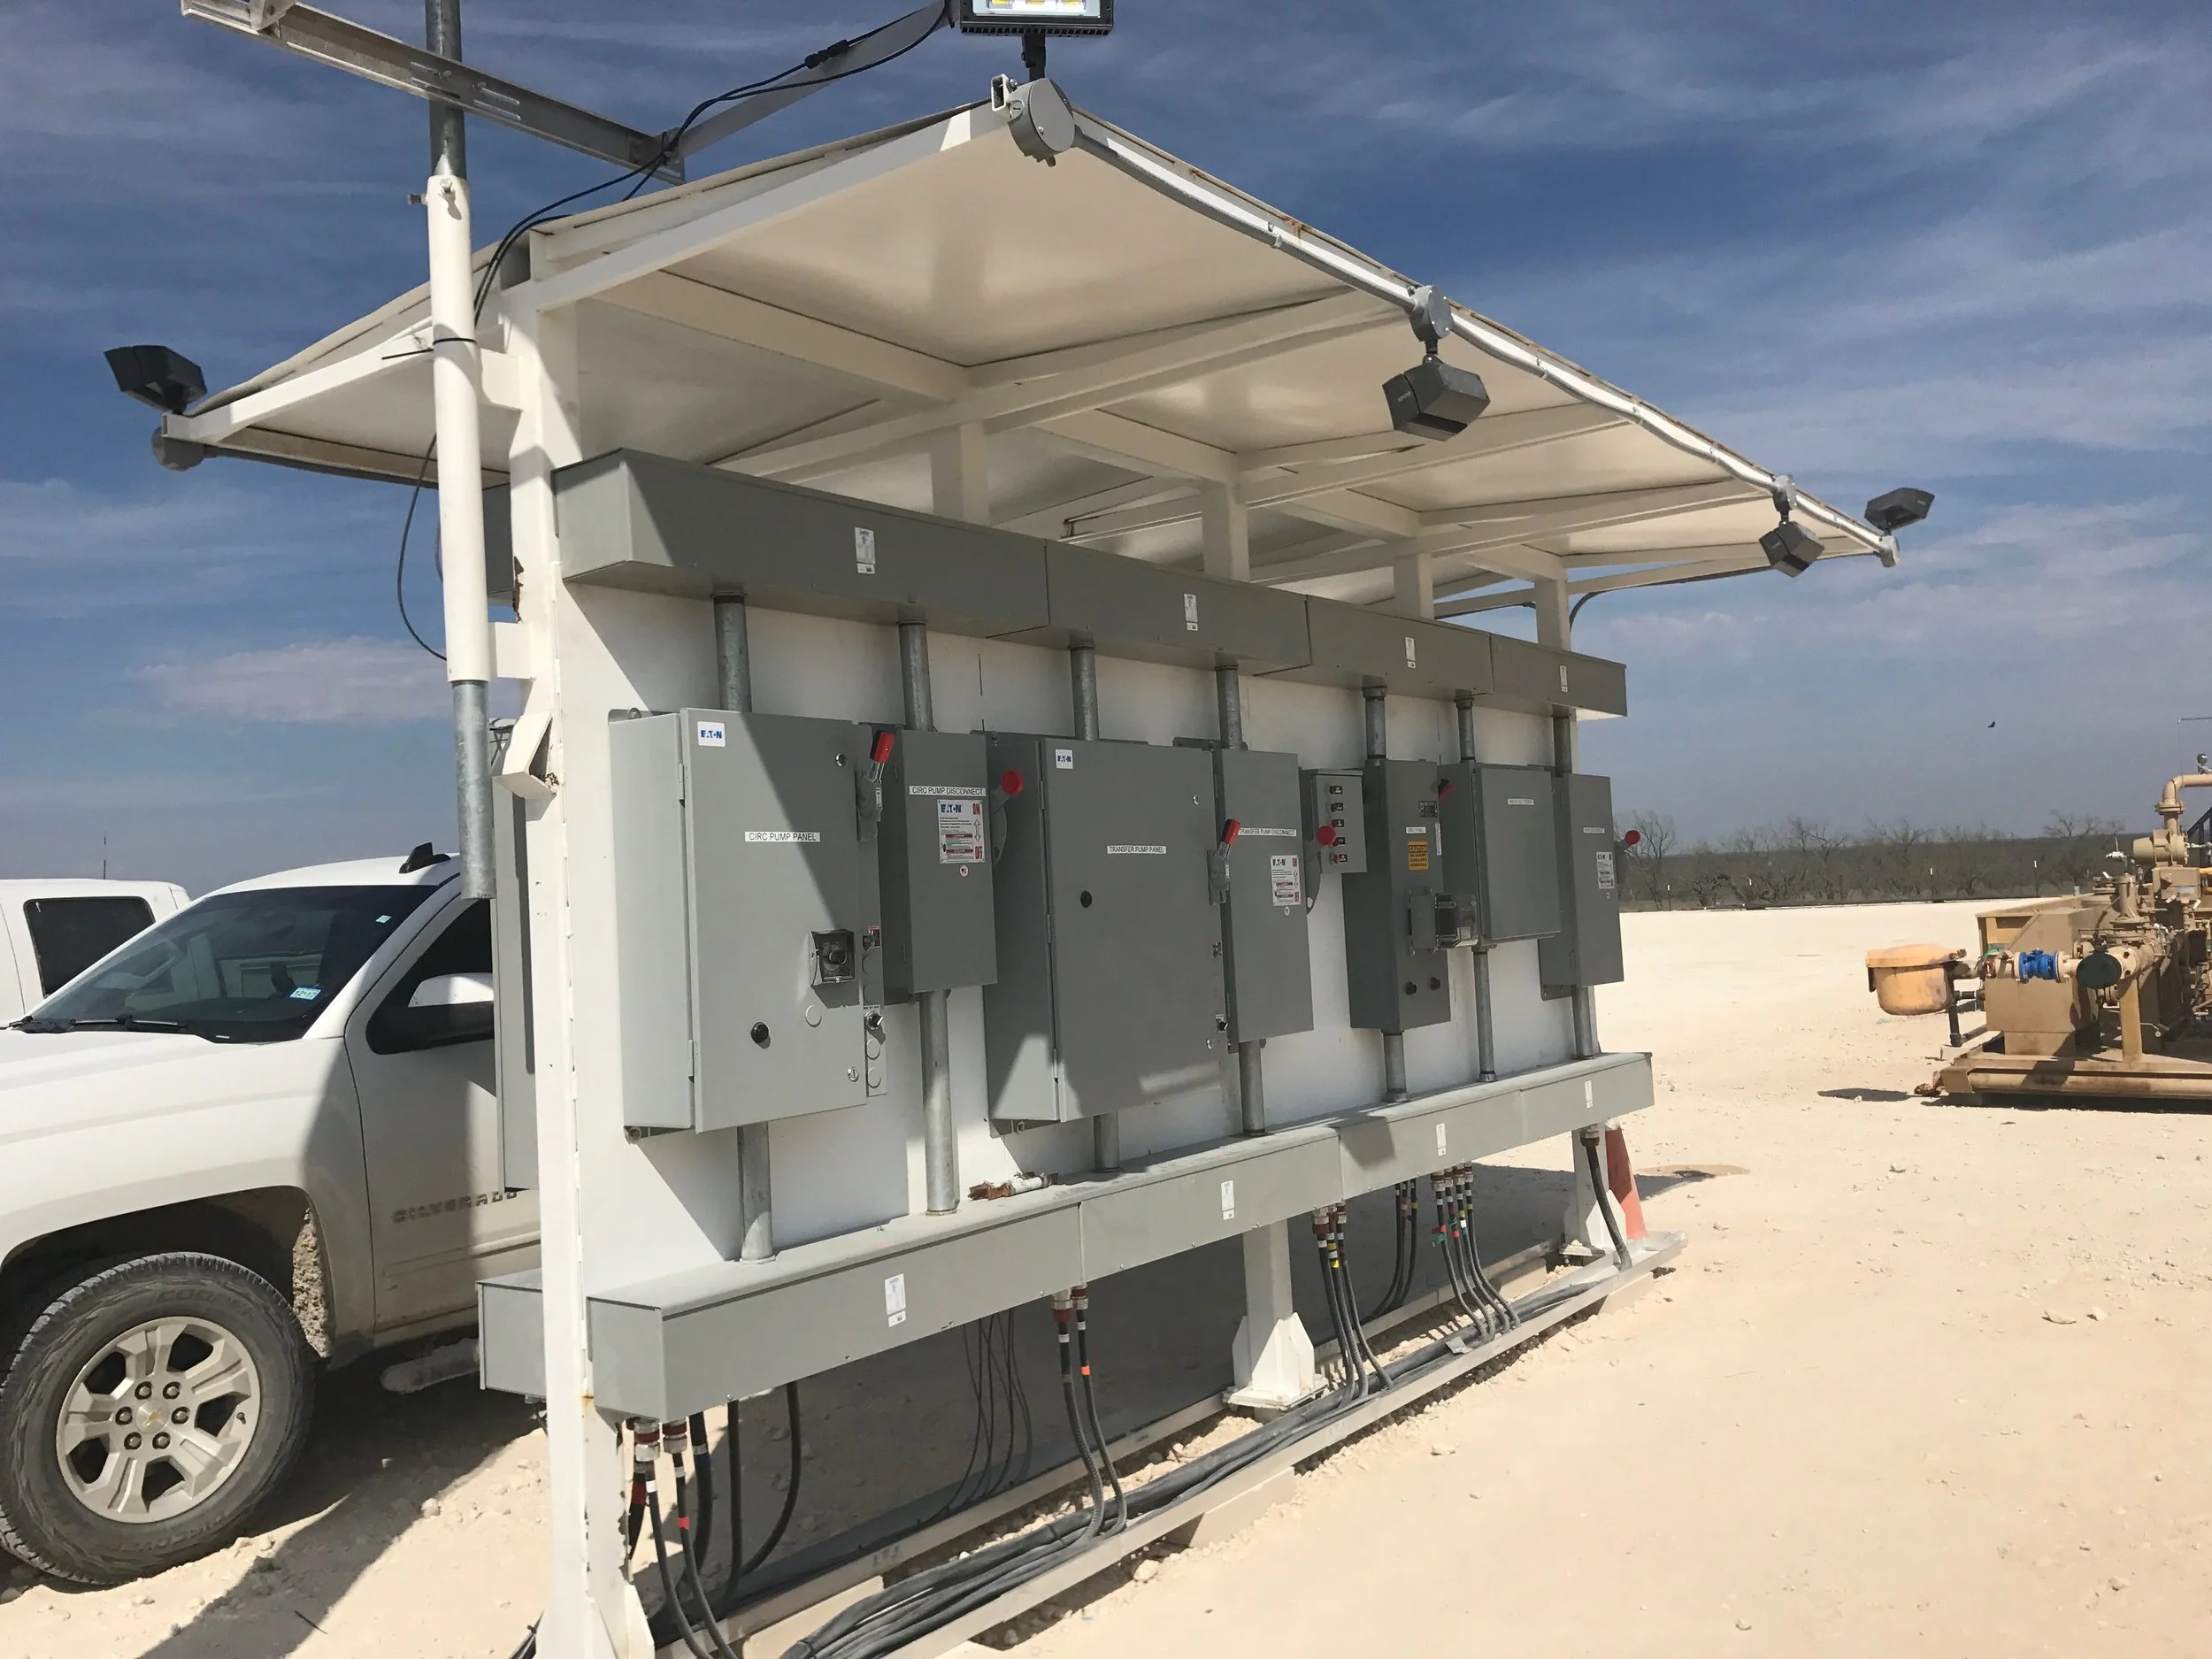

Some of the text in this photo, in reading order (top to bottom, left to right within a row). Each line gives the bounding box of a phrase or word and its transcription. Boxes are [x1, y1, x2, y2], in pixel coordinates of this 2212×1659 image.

[749, 832, 817, 841] CIRC PUMP PANEL
[393, 1190, 518, 1224] SILVERADO
